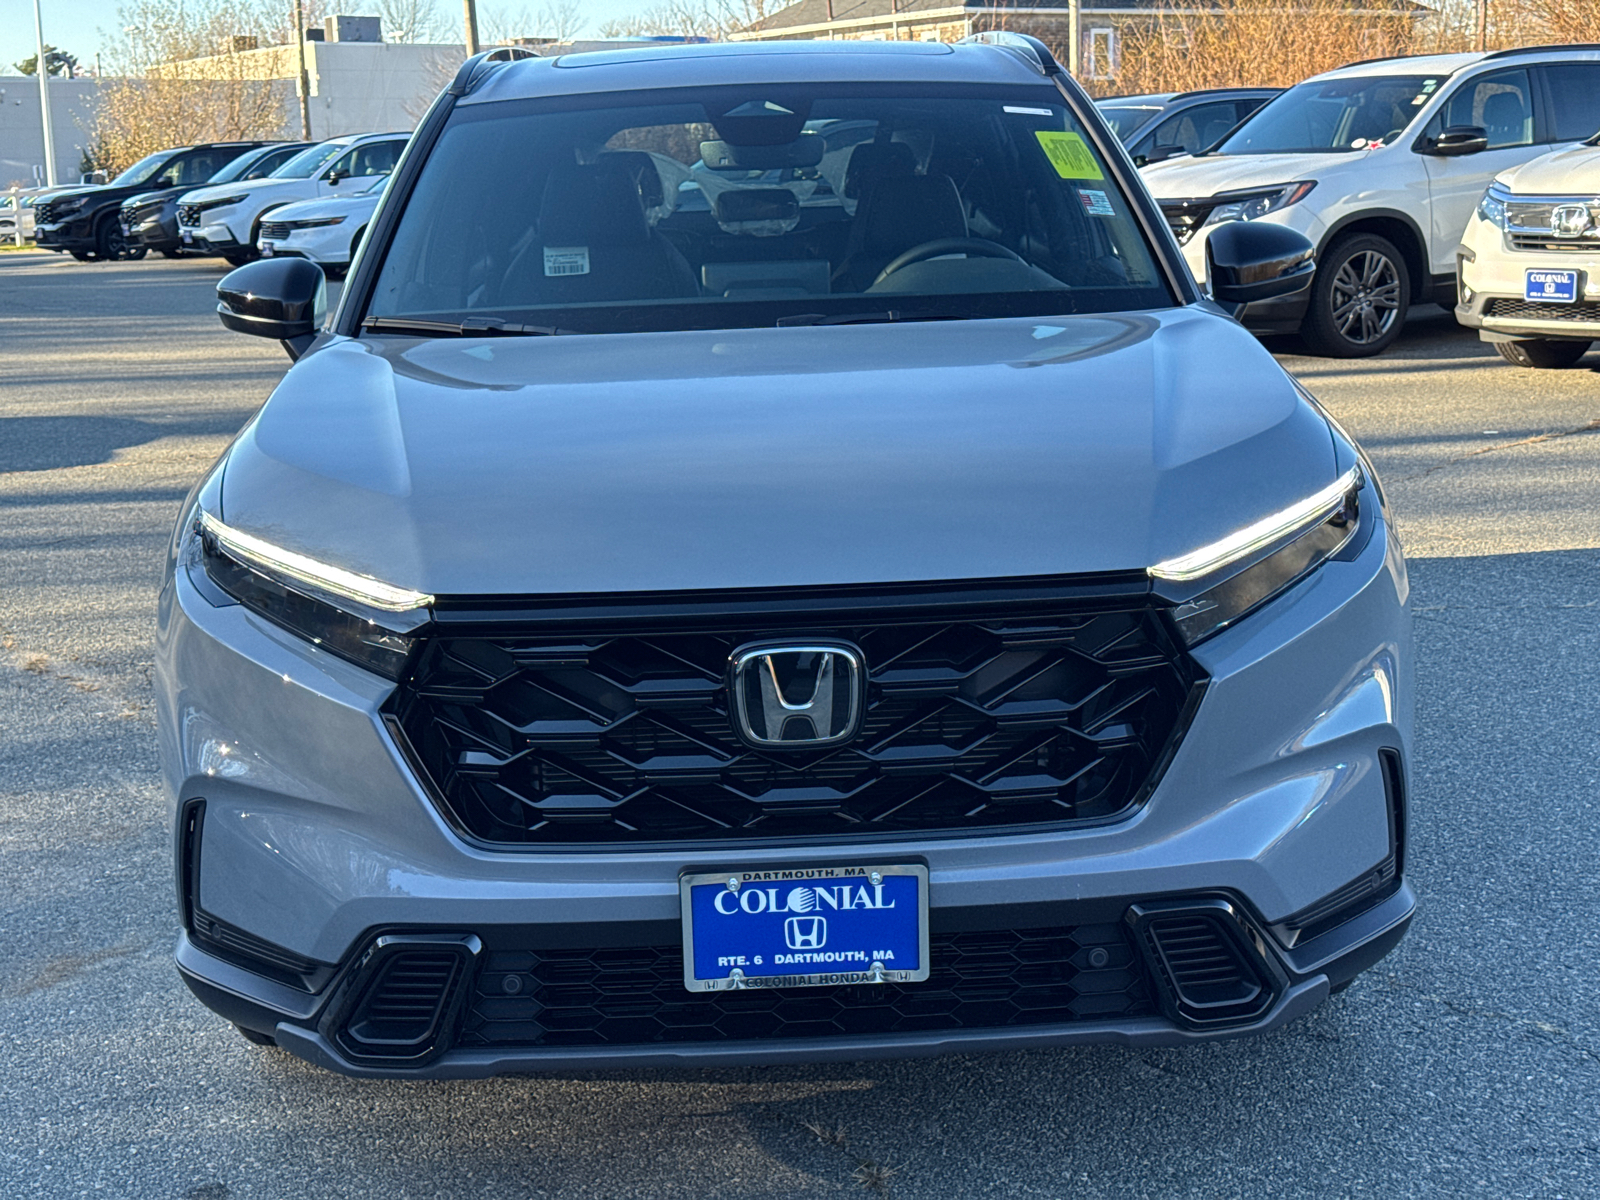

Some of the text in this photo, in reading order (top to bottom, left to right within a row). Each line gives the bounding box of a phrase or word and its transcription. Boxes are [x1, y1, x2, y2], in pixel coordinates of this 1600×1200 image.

[1530, 274, 1571, 283] COLONIAL
[844, 867, 866, 876] MA
[713, 884, 896, 915] COLONIAL
[718, 949, 895, 967] RTE. 6 DARTMOUTH, MA
[745, 972, 869, 988] COLONIAL HONDA
